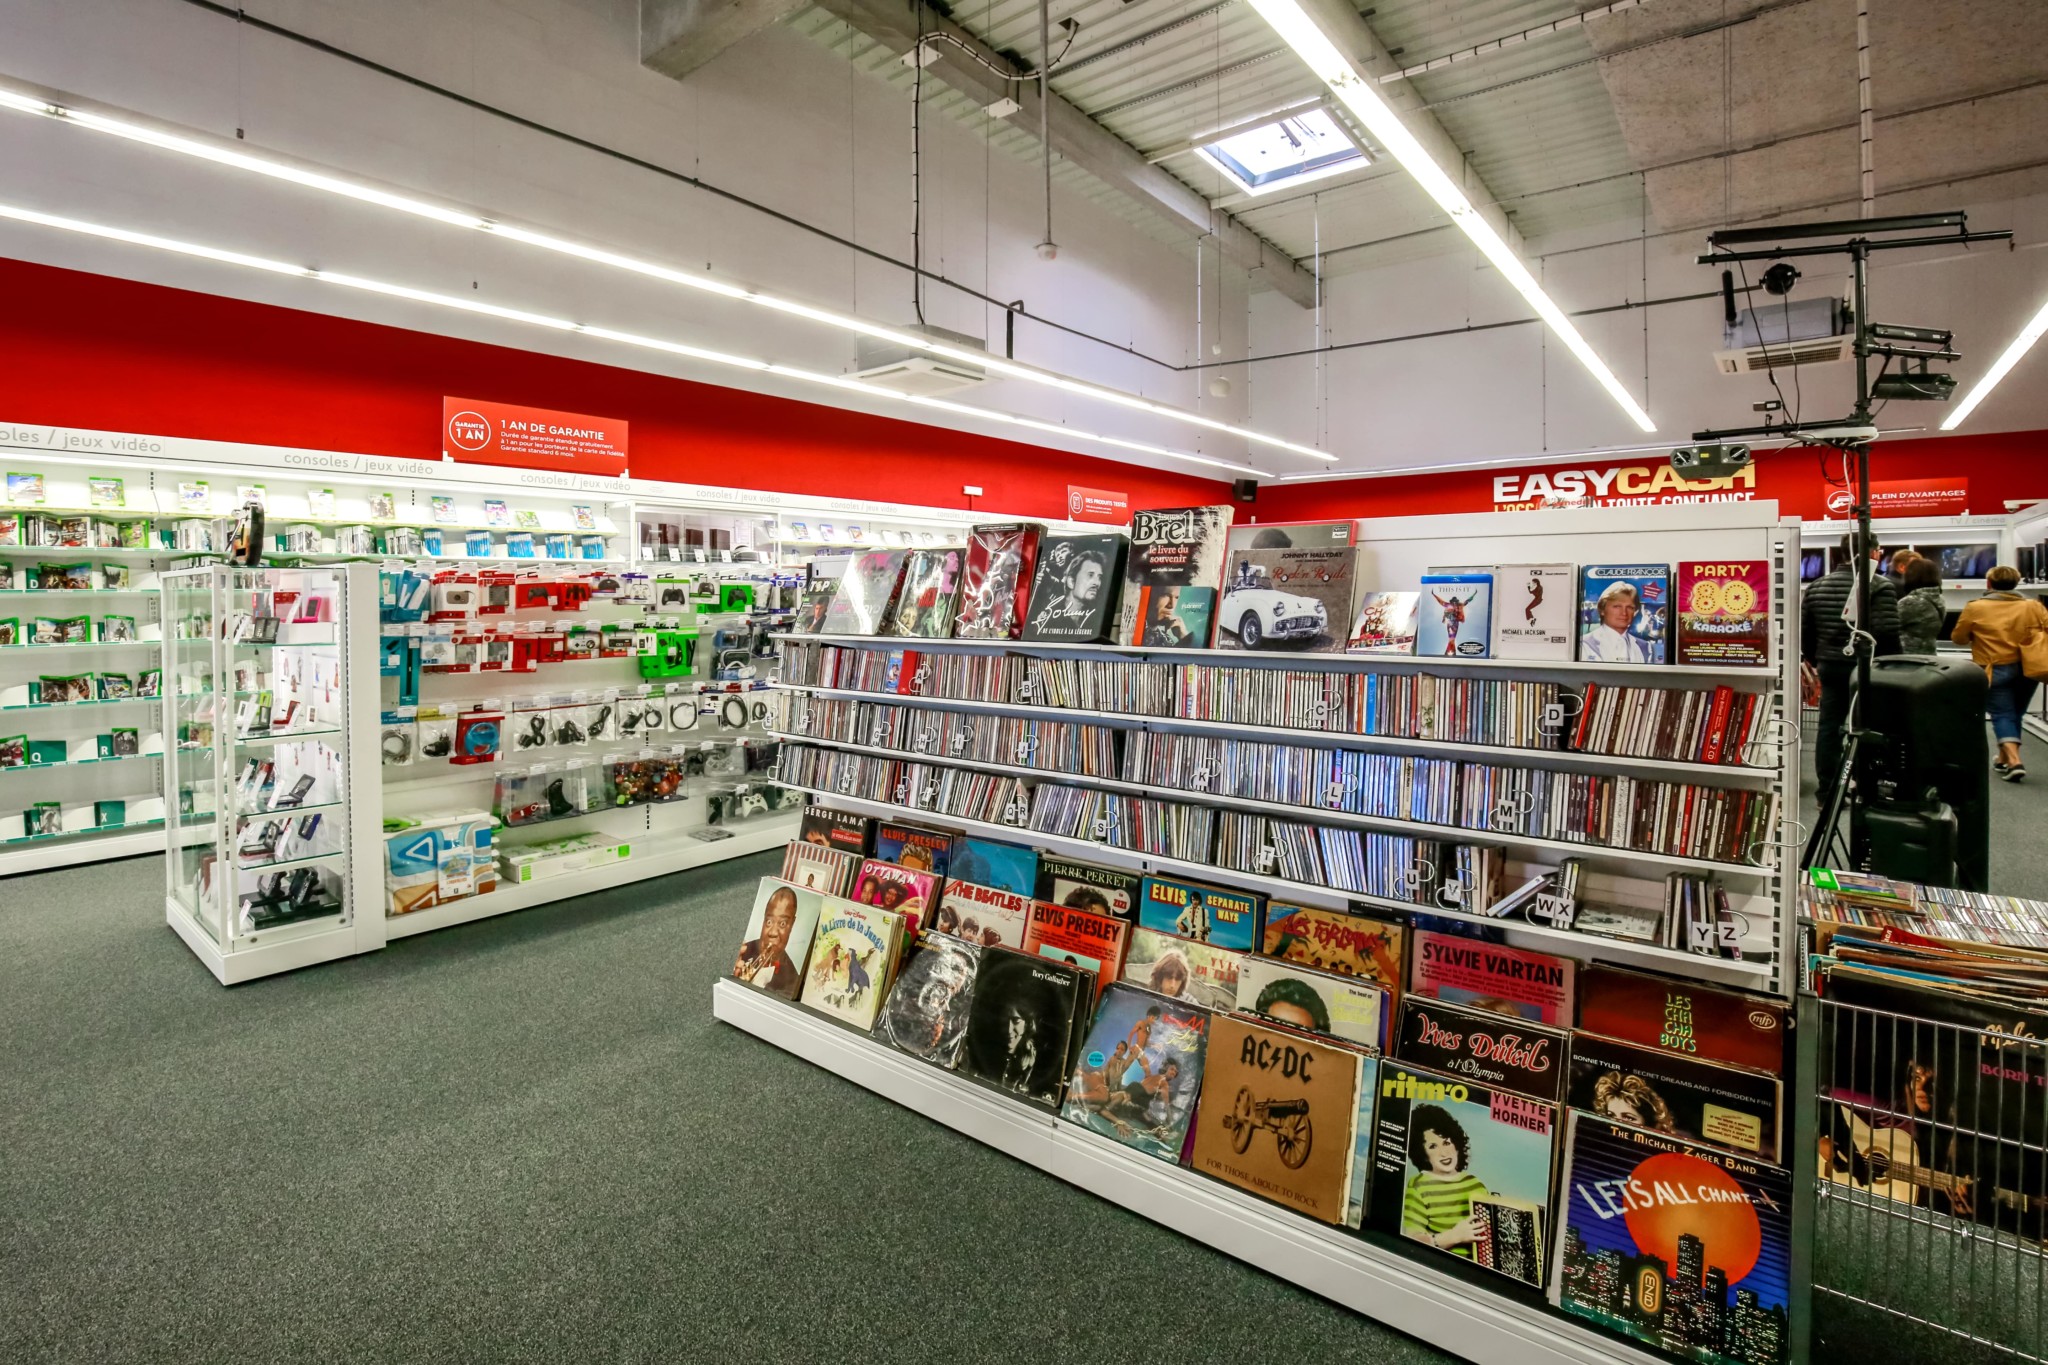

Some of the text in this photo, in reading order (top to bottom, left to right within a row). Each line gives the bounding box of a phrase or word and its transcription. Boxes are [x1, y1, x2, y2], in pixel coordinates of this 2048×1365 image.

[455, 421, 485, 430] GARANTIE
[501, 419, 605, 441] 1 AN DE GARANTIE
[456, 428, 485, 441] 1 AN
[501, 431, 520, 439] Durée
[530, 434, 554, 443] garantie
[62, 433, 162, 453] jeux vidéo
[501, 444, 527, 453] Garantie
[528, 447, 554, 456] standard
[284, 451, 434, 476] consoles jeux vidéo
[520, 472, 632, 492] consoles jeux vidéo
[696, 489, 781, 504] consoles jeux vidéo
[1900, 489, 1967, 499] D'AVANTAGES
[1972, 515, 2006, 525] cinéma
[1132, 510, 1196, 545] Brel
[278, 544, 284, 552] B
[1157, 544, 1177, 554] livre
[1178, 544, 1189, 554] du
[1150, 554, 1187, 563] souvenir
[1597, 567, 1666, 577] CLAUDE FRANÇOIS
[1694, 564, 1751, 577] PARTY
[30, 579, 39, 589] D
[1691, 580, 1755, 615] 80
[1501, 628, 1546, 636] MICHAEL JACKSON
[1692, 620, 1752, 634] KARAOKÉ
[917, 673, 923, 681] A
[1024, 684, 1030, 693] B
[33, 693, 40, 703] L
[1316, 706, 1325, 715] C
[1549, 709, 1560, 721] D
[874, 731, 880, 739] G
[101, 745, 108, 755] R
[1021, 745, 1026, 755] J
[31, 752, 42, 763] Q
[1199, 772, 1206, 781] K
[898, 787, 903, 796] O
[1332, 787, 1338, 796] L
[101, 812, 108, 822] X
[804, 806, 864, 827] SERGE LAMA
[1007, 807, 1013, 817] Q
[1020, 807, 1026, 816] R
[1500, 805, 1512, 817] M
[1098, 823, 1104, 832] S
[882, 828, 948, 849] ELVIS PRESLEY
[1264, 850, 1271, 860] T
[865, 863, 917, 885] OTTAWAN
[1044, 862, 1130, 888] PIERRE PERRET
[1407, 873, 1416, 884] U
[948, 880, 975, 900] THE
[974, 887, 1023, 912] BEATLES
[1448, 884, 1459, 896] V
[1112, 898, 1127, 910] ZIZI
[1152, 883, 1250, 914] ELVIS SEPARATE
[1538, 899, 1555, 913] W
[1558, 902, 1570, 916] X
[1216, 909, 1239, 923] WAYS
[1033, 905, 1065, 927] ELVIS
[1066, 914, 1121, 943] PRESLEY
[828, 917, 885, 953] Livre de la Jungle
[1697, 928, 1709, 941] Y
[1723, 927, 1737, 941] Z
[1210, 957, 1241, 973] YVES
[1422, 942, 1481, 970] SYLVIE
[1484, 954, 1564, 987] VARTAN
[1032, 969, 1072, 988] Rory Gallagher
[1666, 993, 1692, 1011] LES
[1664, 1007, 1693, 1025] CHA
[1752, 1012, 1774, 1027] mfp
[1664, 1021, 1693, 1038] CHA
[1417, 1012, 1550, 1072] Yves Duteil
[1660, 1032, 1697, 1053] BOYS
[1447, 1058, 1505, 1082] à l'Olympia
[1981, 1063, 2029, 1083] BORN
[1572, 1054, 1773, 1108] BONNIE TYLER SECRET DREAMS AND FORBIDDEN FIRE
[1492, 1091, 1547, 1117] YVETTE
[1492, 1107, 1546, 1133] HORNER
[1610, 1125, 1629, 1140] THE
[1633, 1132, 1677, 1154] MICHAEL
[1683, 1146, 1720, 1165] ZAGER
[1725, 1157, 1758, 1176] BAND
[1206, 1157, 1319, 1209] FOR THOSE ABOUT TO ROCK
[1576, 1174, 1698, 1220] LET'S ALL
